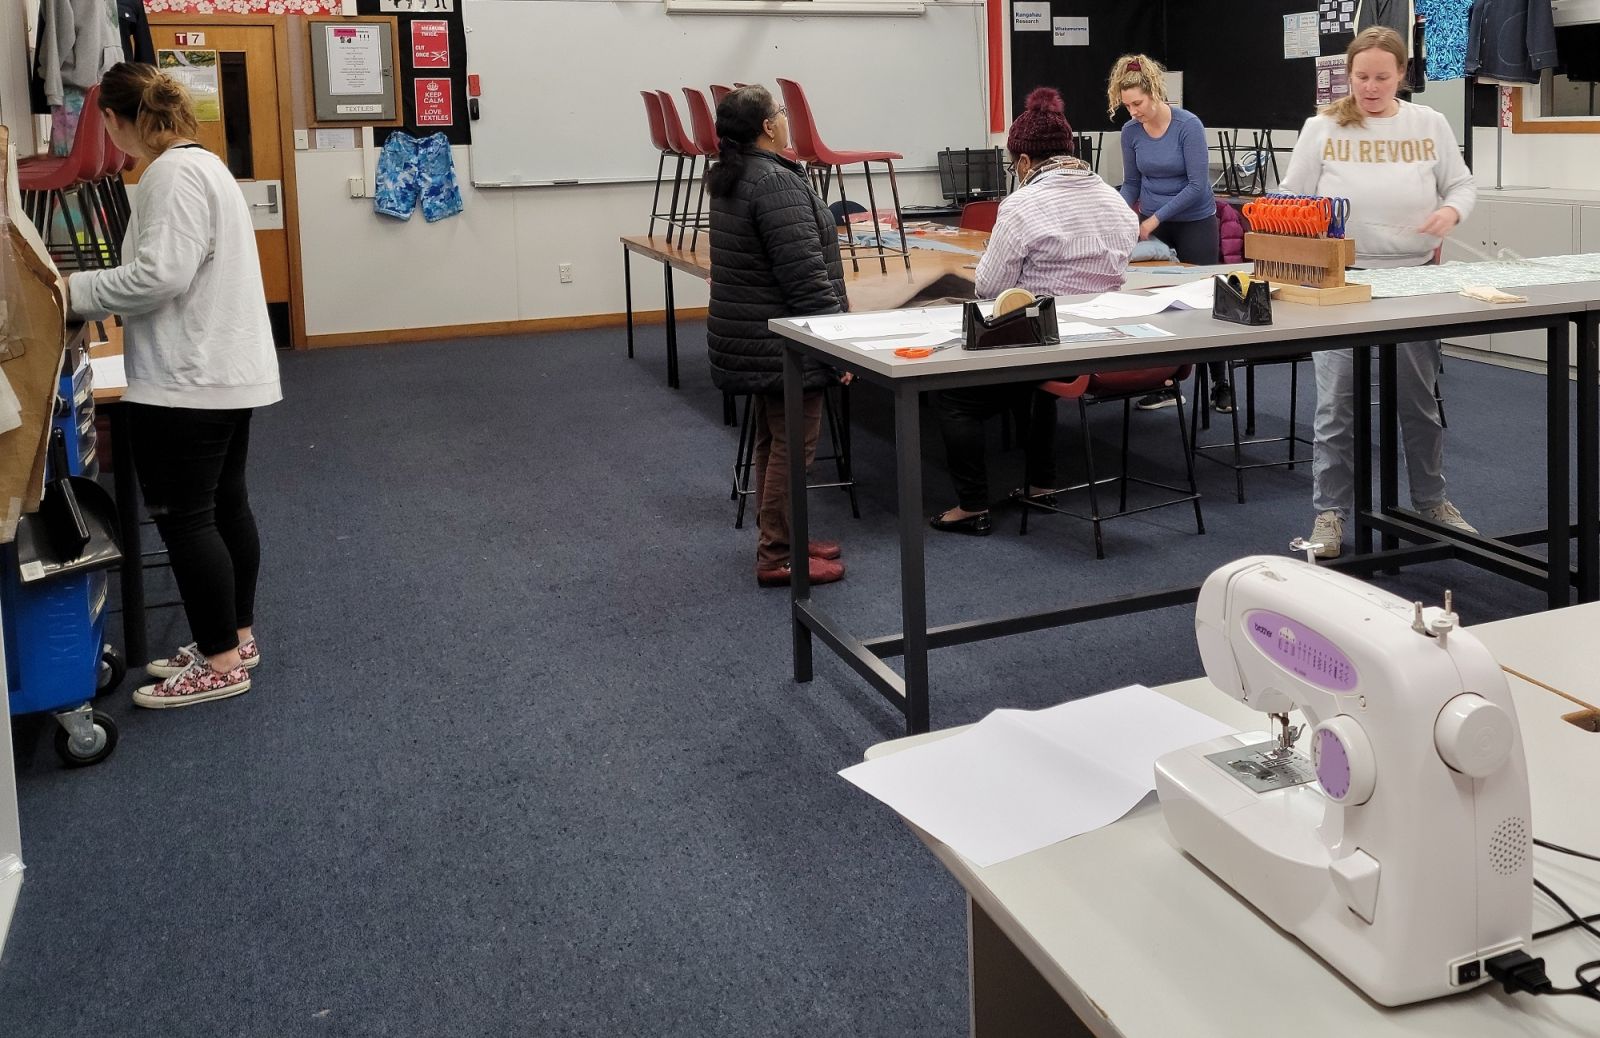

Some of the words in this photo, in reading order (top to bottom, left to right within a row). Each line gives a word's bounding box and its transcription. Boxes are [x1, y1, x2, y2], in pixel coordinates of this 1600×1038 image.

[176, 33, 186, 44] T
[191, 33, 200, 44] 7
[1323, 138, 1350, 162] AU
[1359, 138, 1437, 163] REVOIR
[1254, 622, 1273, 638] brother
